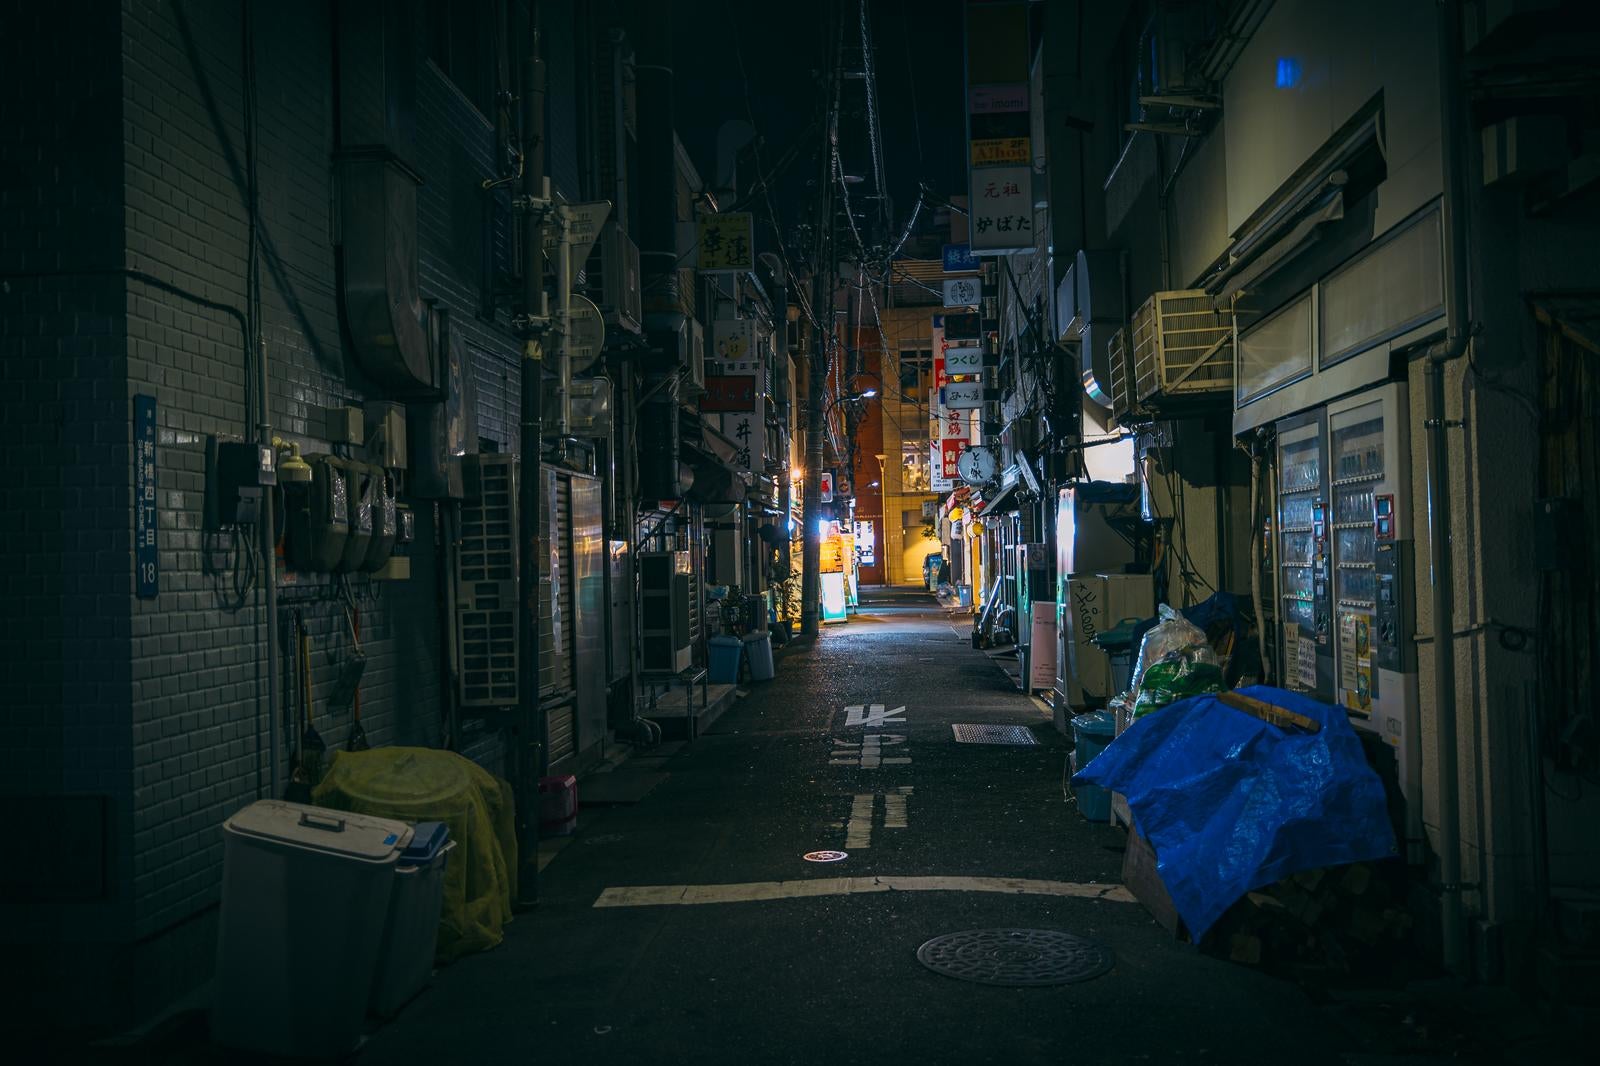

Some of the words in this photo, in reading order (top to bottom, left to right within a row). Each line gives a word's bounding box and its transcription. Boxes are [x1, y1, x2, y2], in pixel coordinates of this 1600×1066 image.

[983, 181, 1021, 198] 元祖
[976, 214, 1031, 234] 炉ばた
[948, 355, 979, 365] つくし
[735, 418, 753, 470] 井筒
[142, 562, 155, 585] 18
